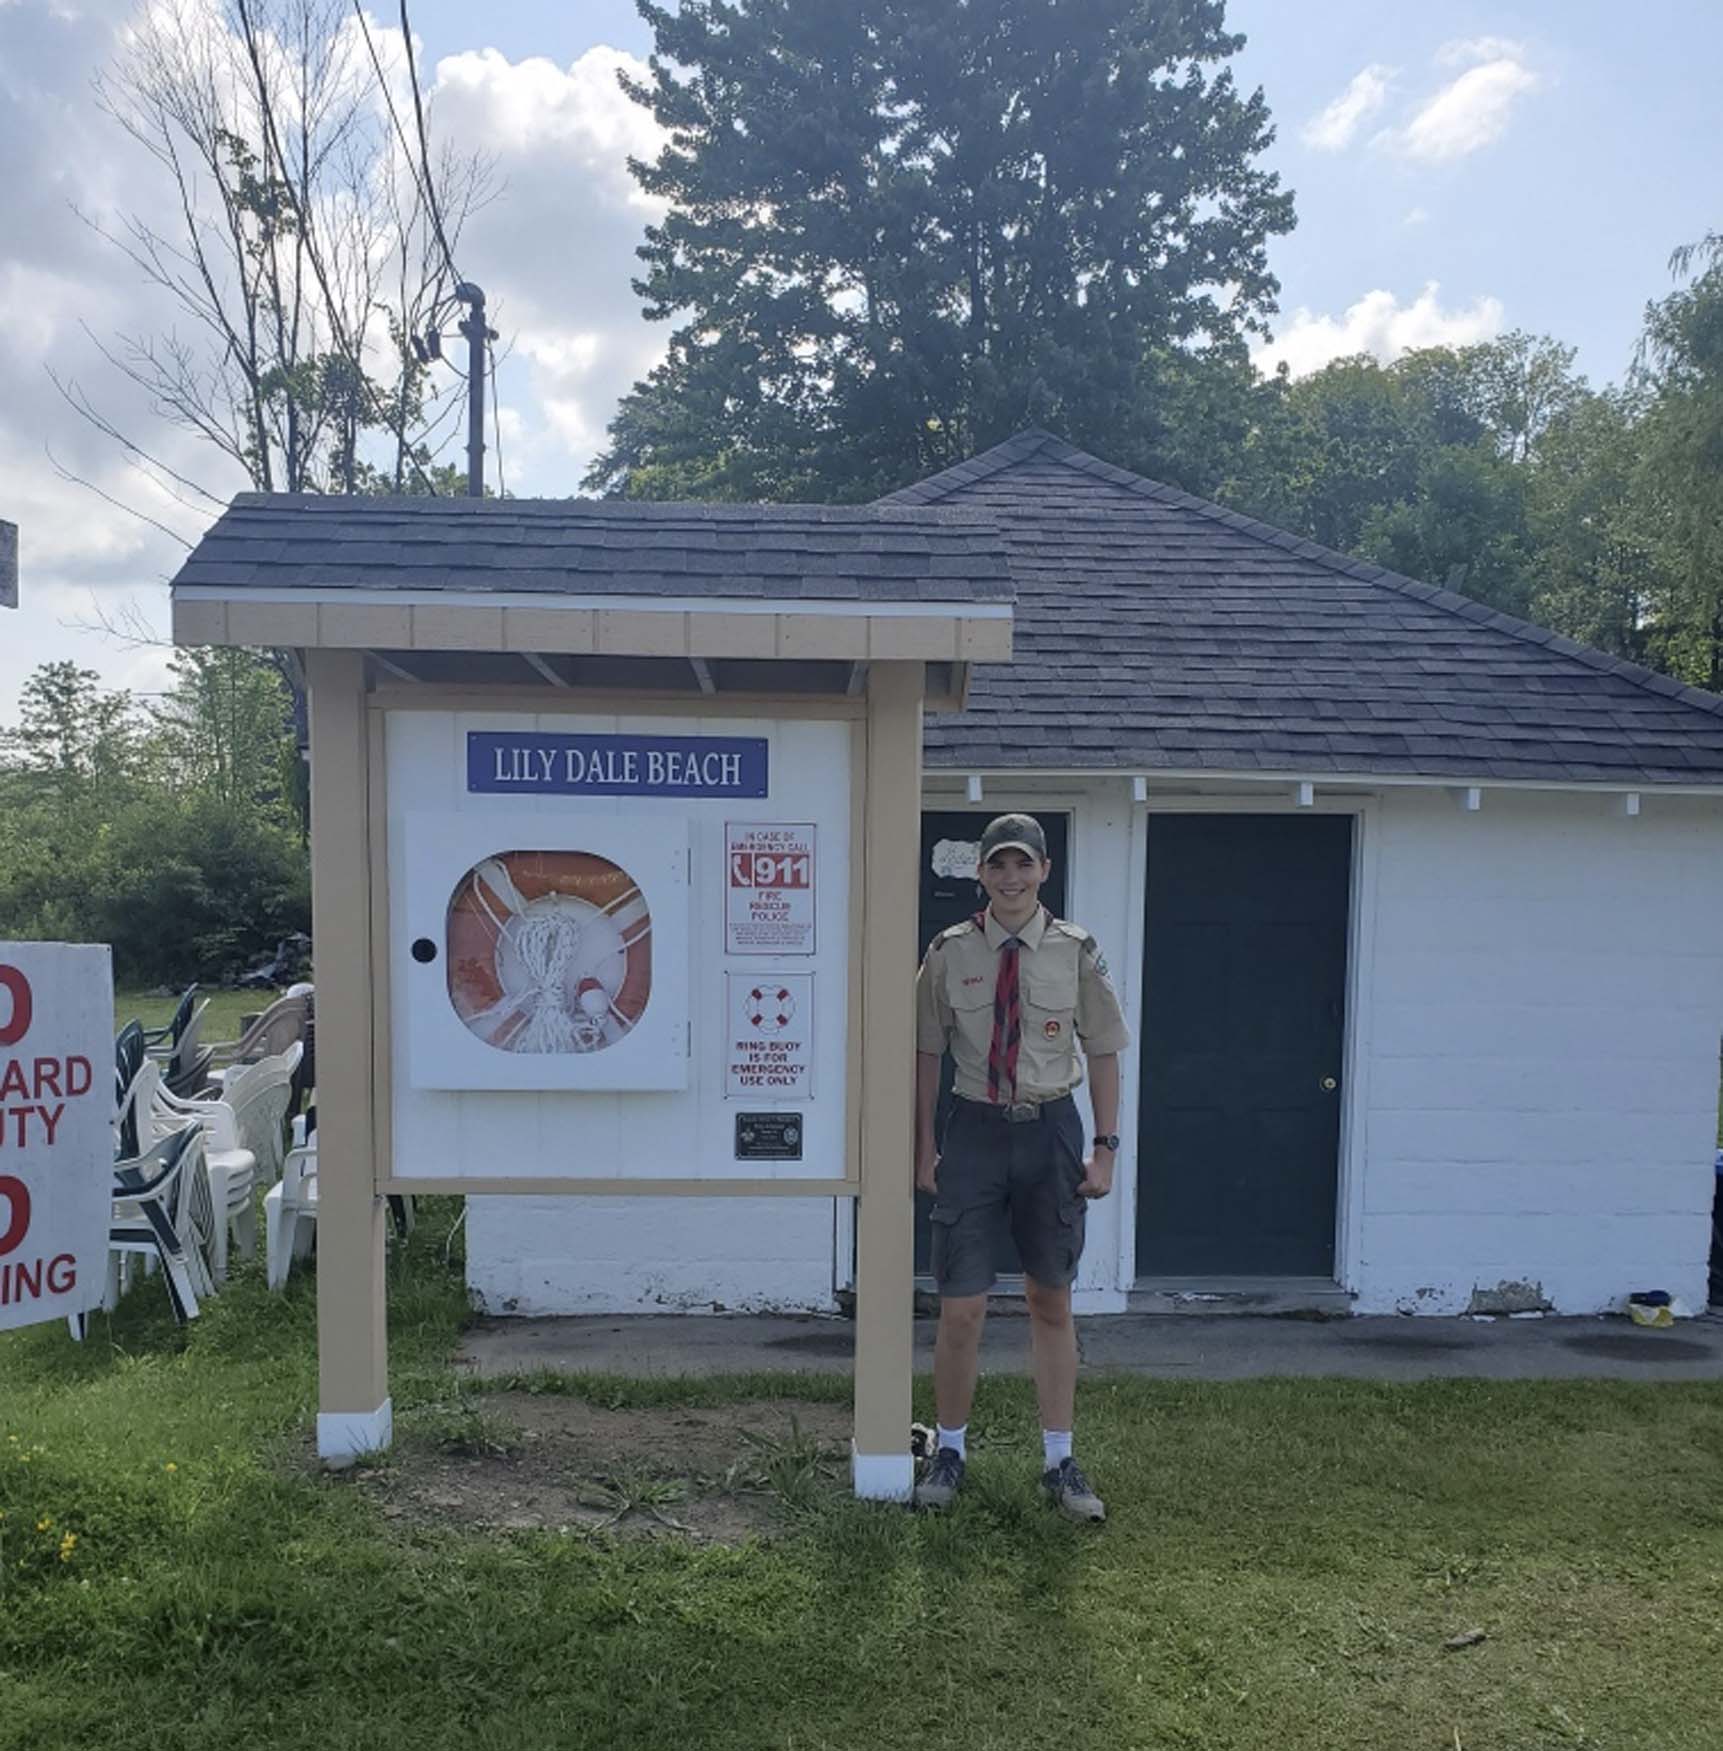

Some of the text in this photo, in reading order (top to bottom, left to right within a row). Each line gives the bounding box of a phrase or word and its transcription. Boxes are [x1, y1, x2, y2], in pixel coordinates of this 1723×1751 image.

[493, 748, 742, 785] LILY DALE BEACH
[756, 856, 808, 885] 911
[759, 891, 782, 901] FIRE
[752, 911, 789, 921] POLICE
[736, 1041, 801, 1052] RING BUOY
[749, 1053, 787, 1062] IS FOR
[731, 1064, 805, 1074] EMERGENCY
[740, 1075, 798, 1086] USE ONLY
[2, 1253, 76, 1304] ING
